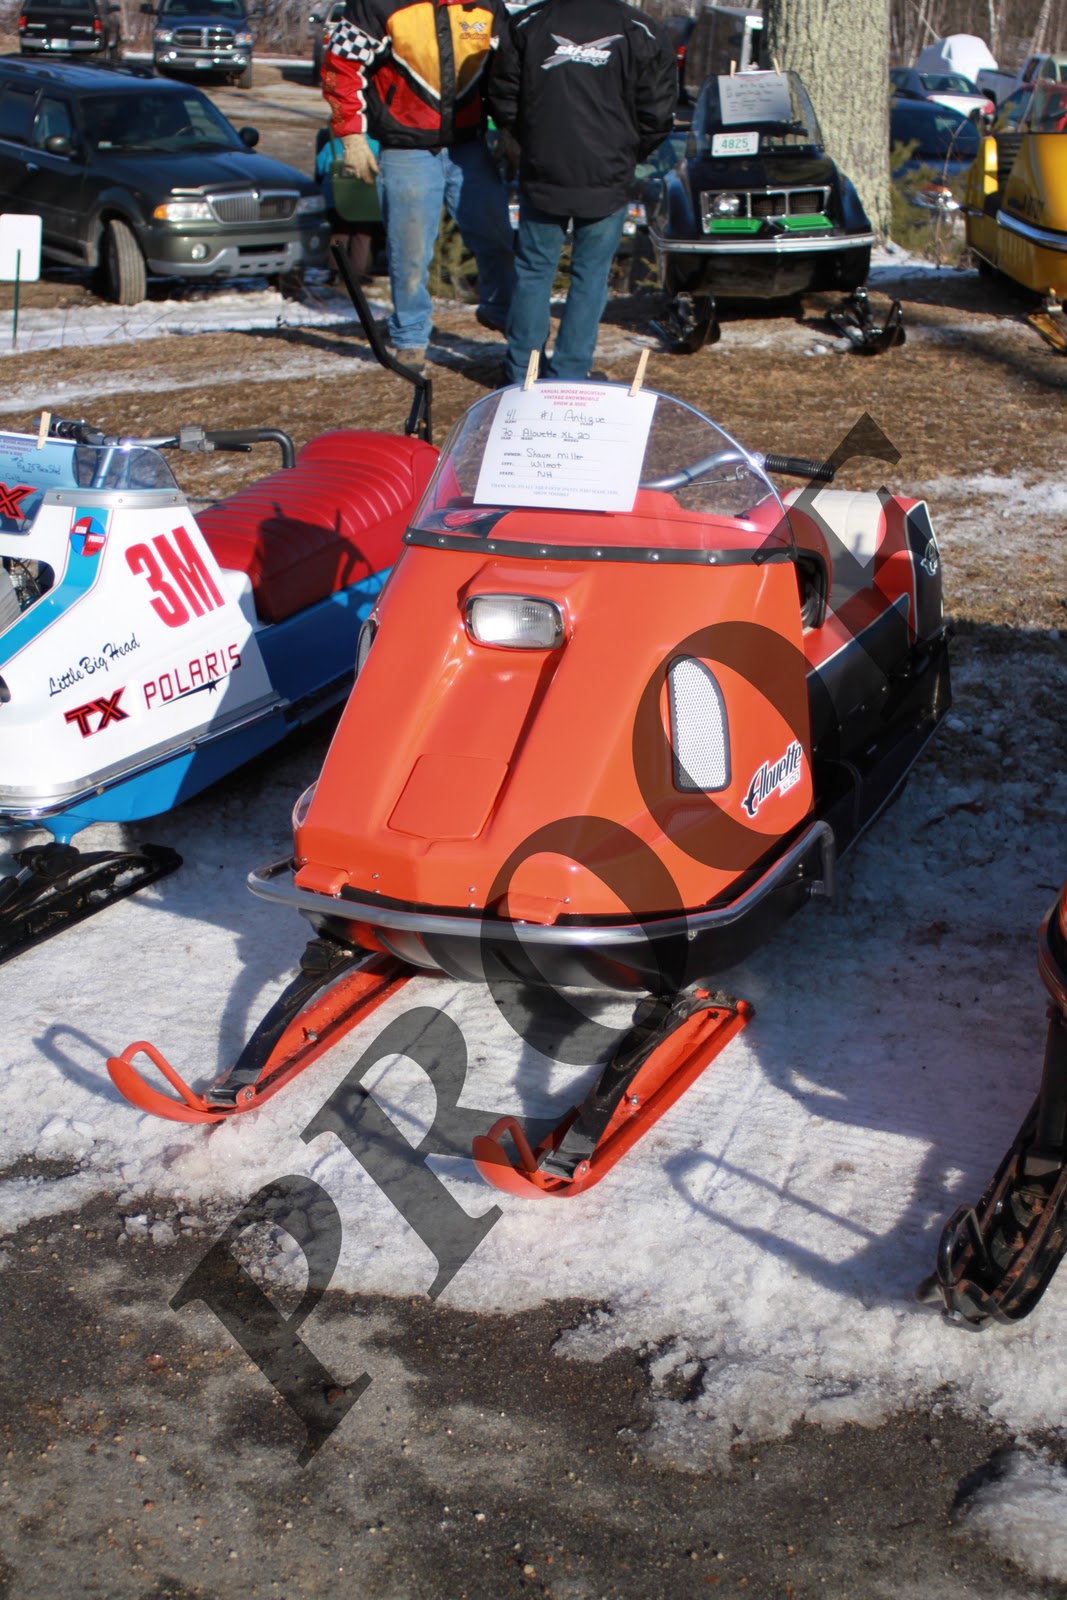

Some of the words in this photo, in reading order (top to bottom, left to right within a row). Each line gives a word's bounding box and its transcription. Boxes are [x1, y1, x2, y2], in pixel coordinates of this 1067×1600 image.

[564, 409, 606, 424] Antique
[530, 460, 562, 469] Wilmot
[537, 470, 553, 478] NH
[125, 525, 226, 628] 3M
[49, 667, 84, 697] Little
[79, 656, 109, 674] Big
[102, 632, 140, 661] Head
[143, 643, 242, 710] POLARIS
[64, 686, 130, 738] TX
